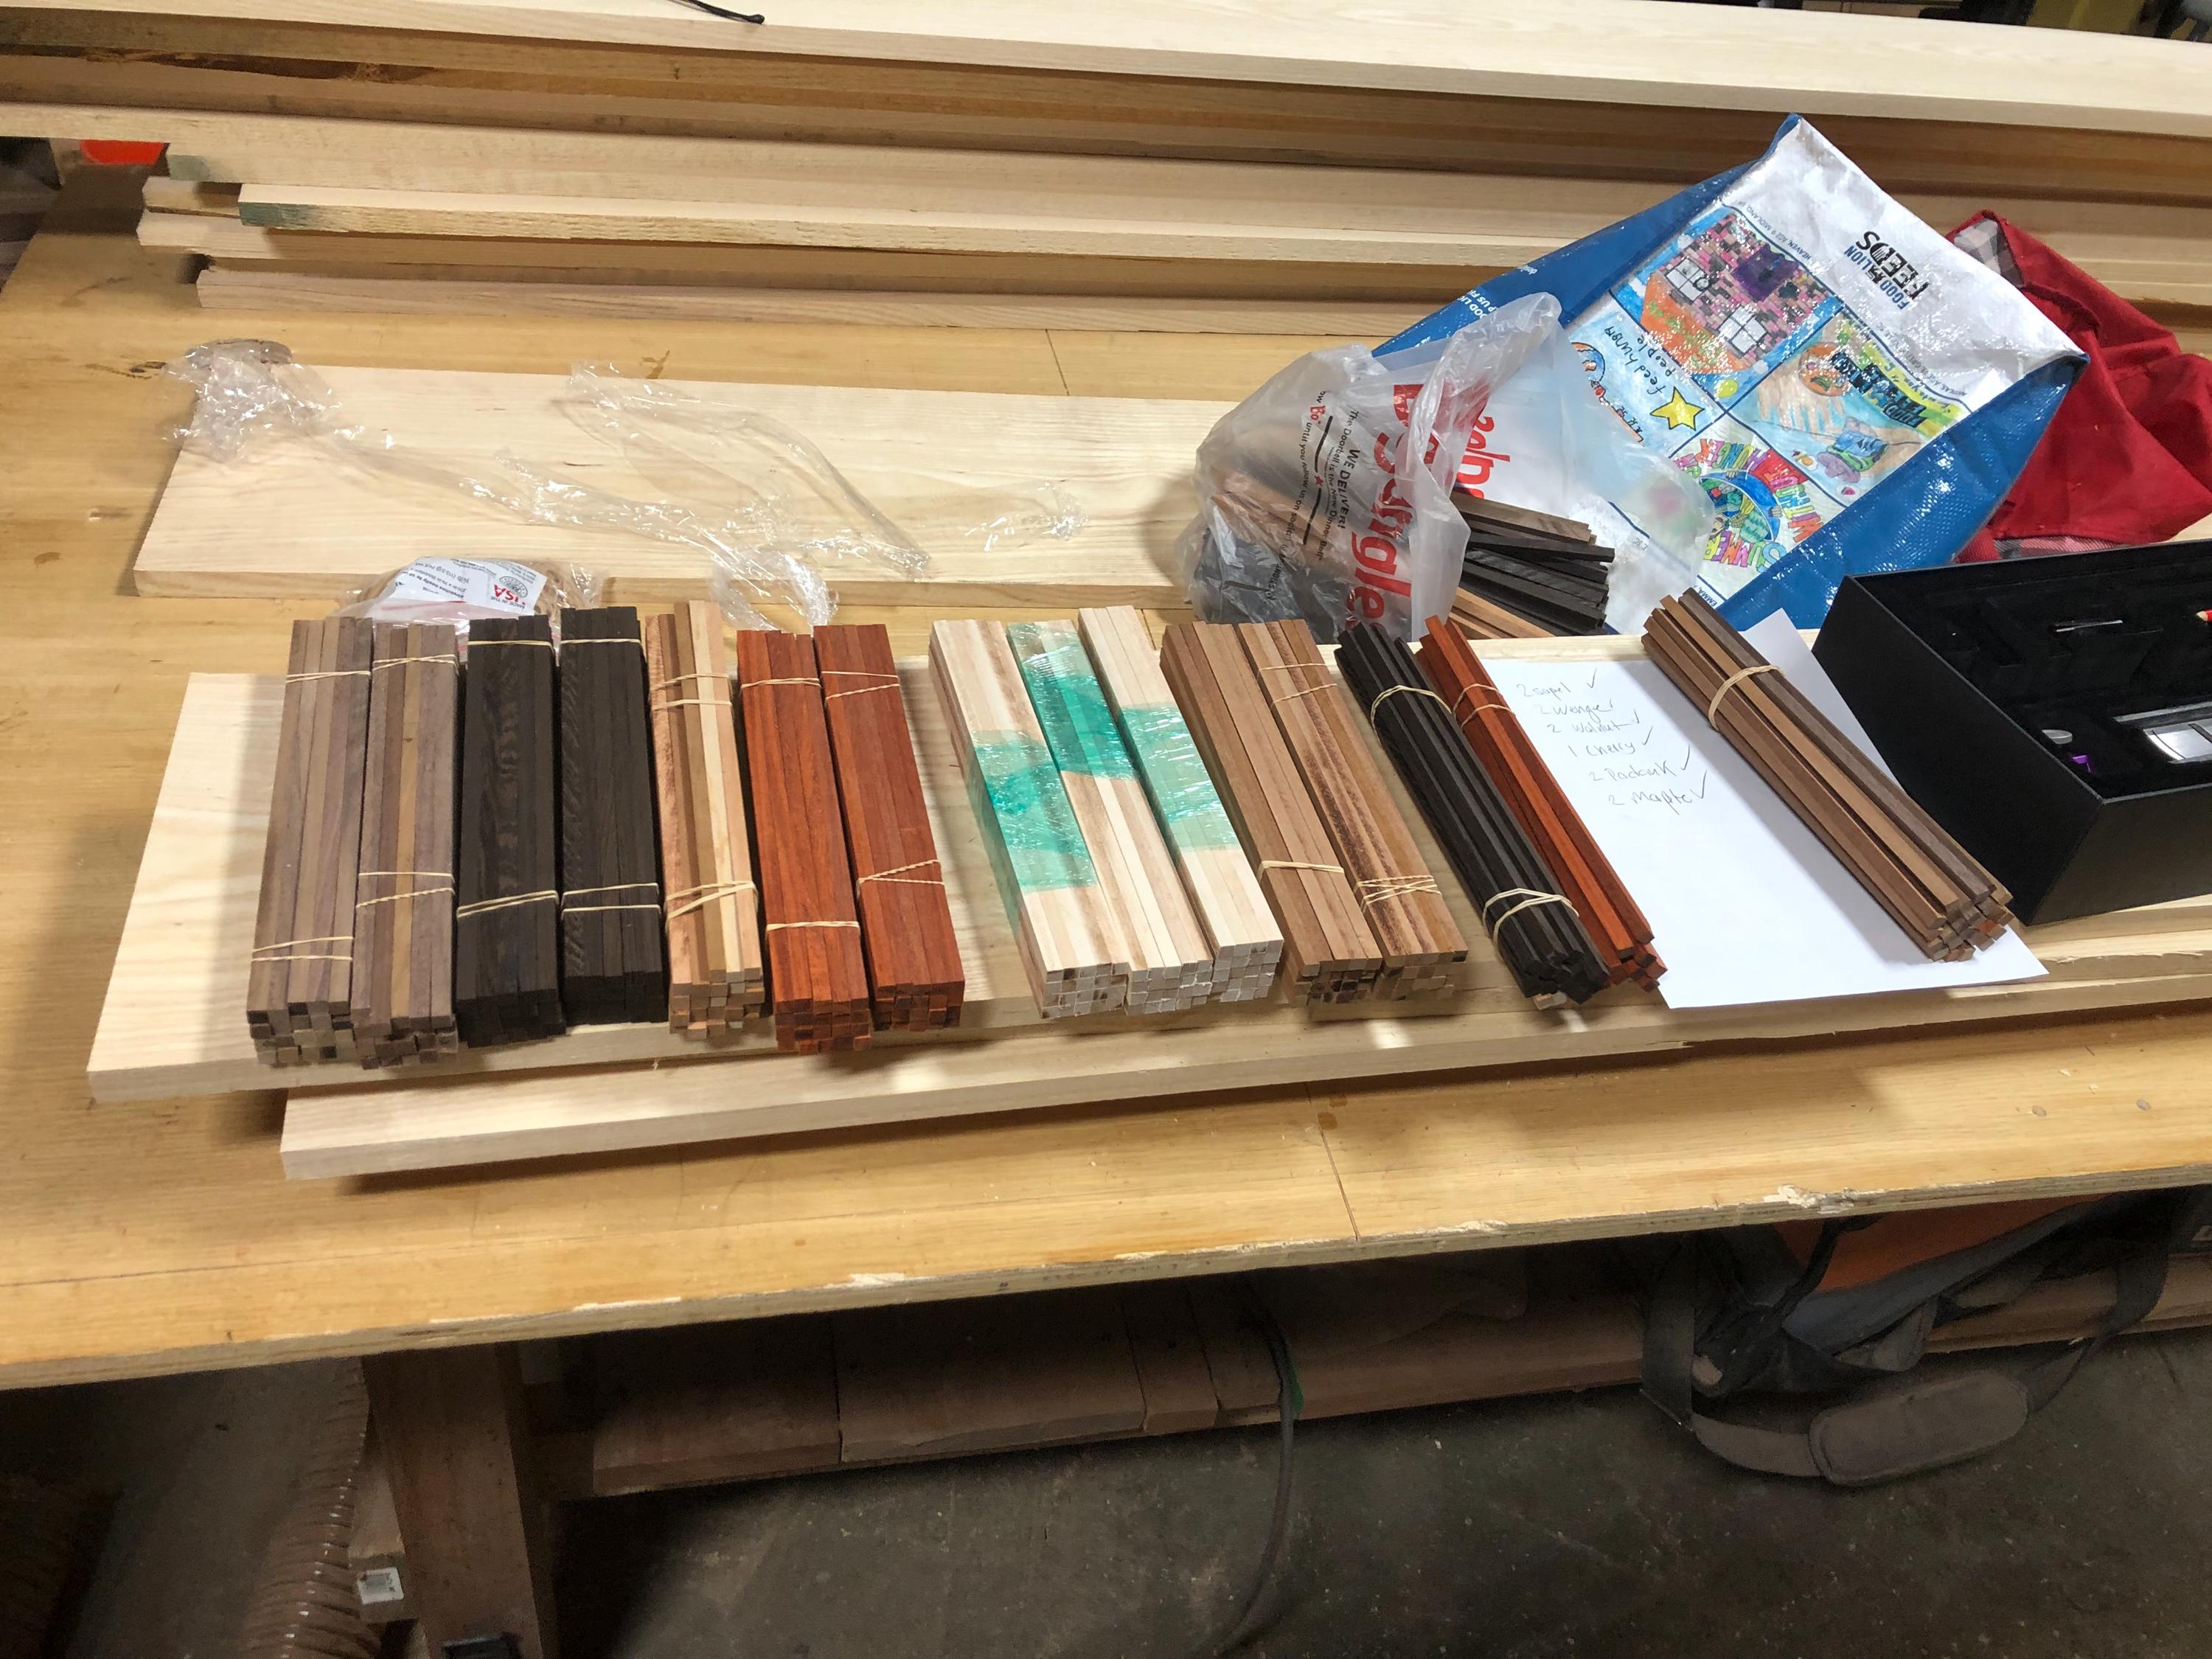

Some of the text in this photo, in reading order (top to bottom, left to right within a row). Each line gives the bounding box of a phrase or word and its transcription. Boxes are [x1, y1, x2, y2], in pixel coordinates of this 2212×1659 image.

[1843, 245, 1910, 310] FOOD LION
[1855, 231, 1930, 300] FEEDS
[1604, 326, 1666, 394] feed hungry
[1637, 334, 1677, 377] people
[1301, 421, 1313, 443] until
[1350, 410, 1360, 427] The
[1333, 428, 1352, 465] Doorbell
[1337, 449, 1360, 529] WE DELIVER!
[1293, 499, 1302, 511] on
[1703, 530, 1787, 573] SUMMER
[493, 584, 526, 605] SA
[1546, 723, 1562, 733] 2
[1588, 771, 1603, 782] 2
[1608, 794, 1625, 806] 2
